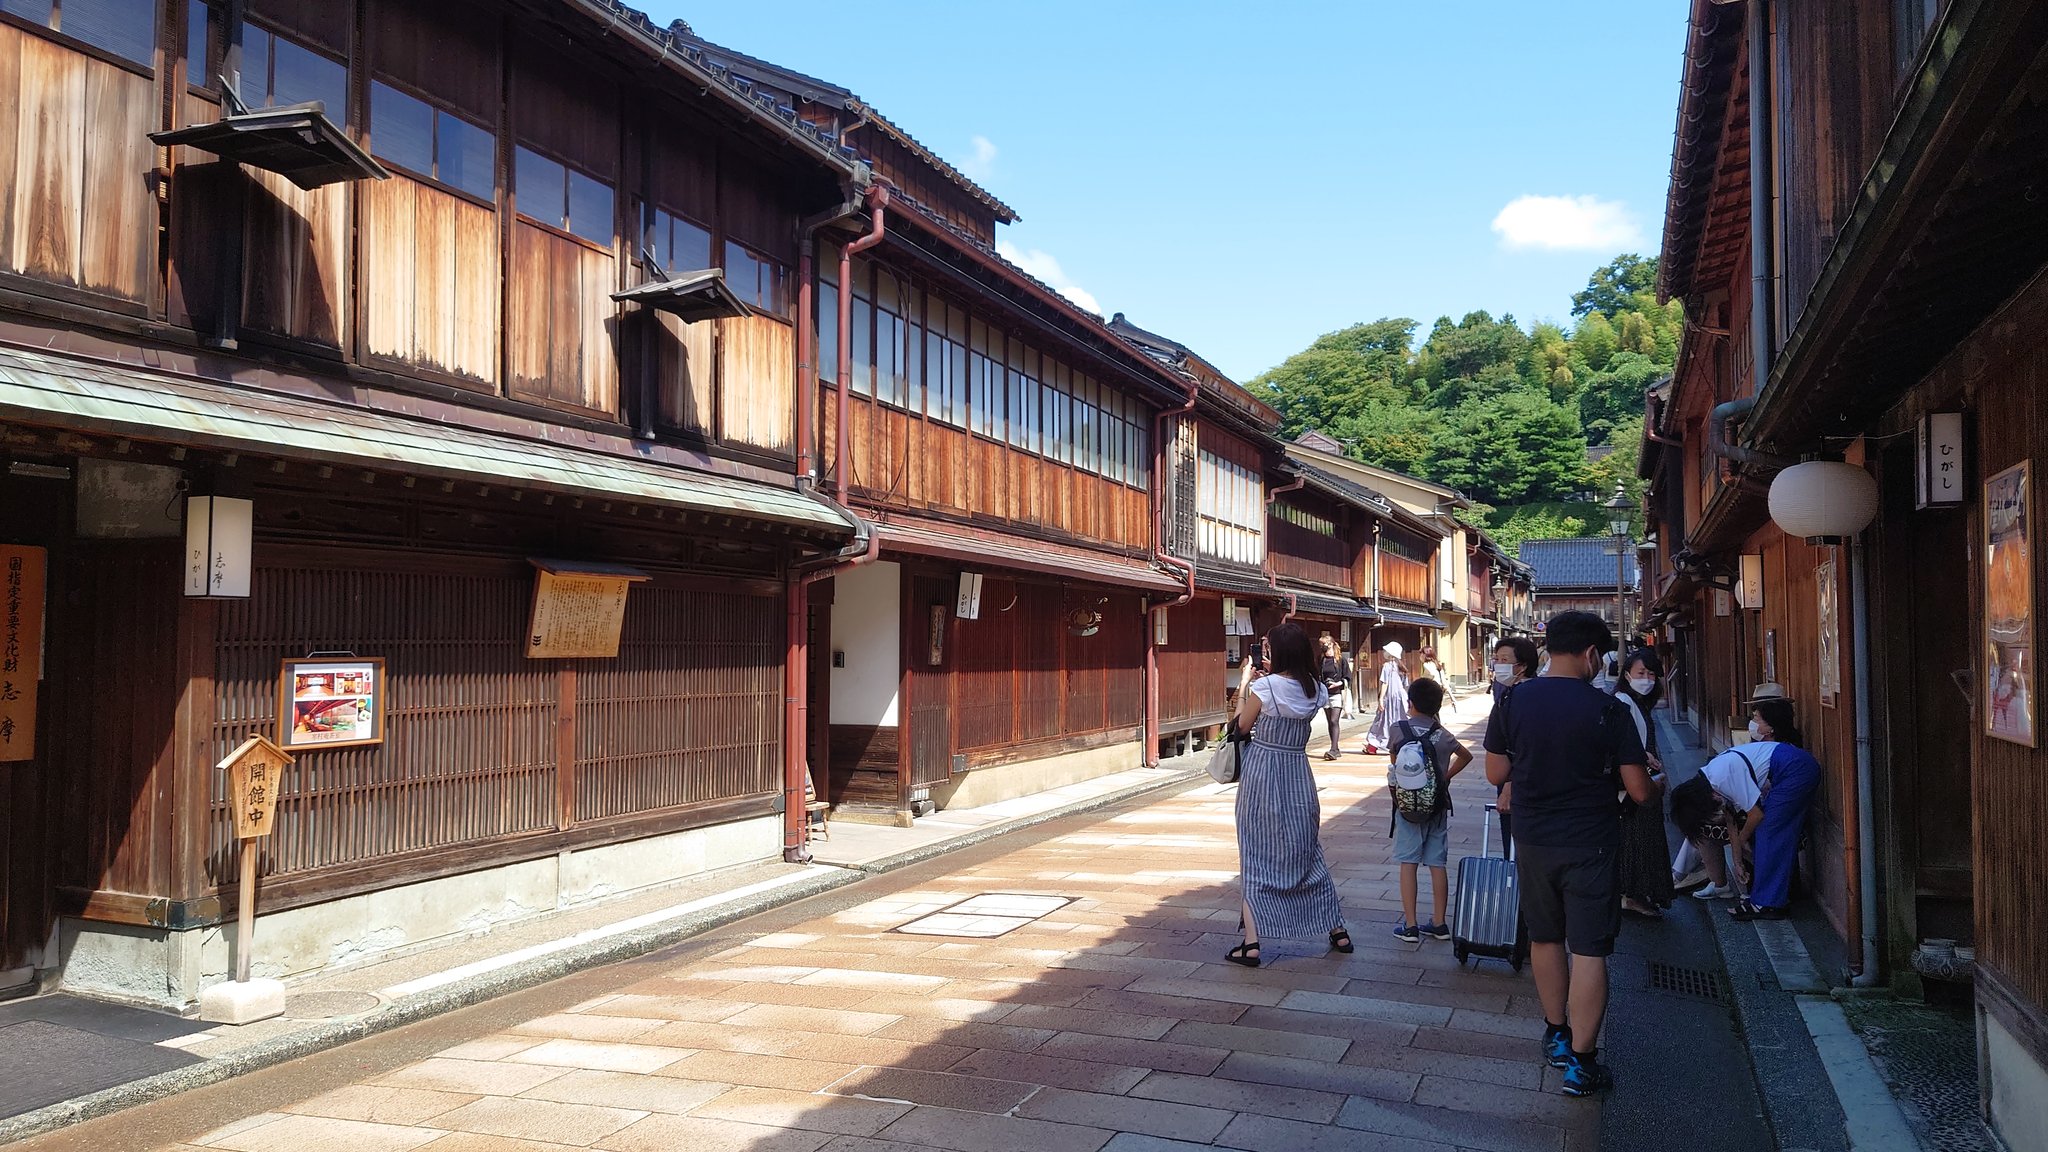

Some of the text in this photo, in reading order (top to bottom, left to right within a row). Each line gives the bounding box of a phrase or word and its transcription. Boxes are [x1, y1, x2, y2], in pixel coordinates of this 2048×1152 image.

[1940, 444, 1954, 489] ひがし
[192, 549, 201, 589] ひがし
[212, 551, 226, 589] 志摩
[960, 593, 968, 613] ひがし
[1749, 580, 1757, 603] ひがし
[0, 680, 22, 744] 志摩
[247, 762, 266, 828] 開館中
